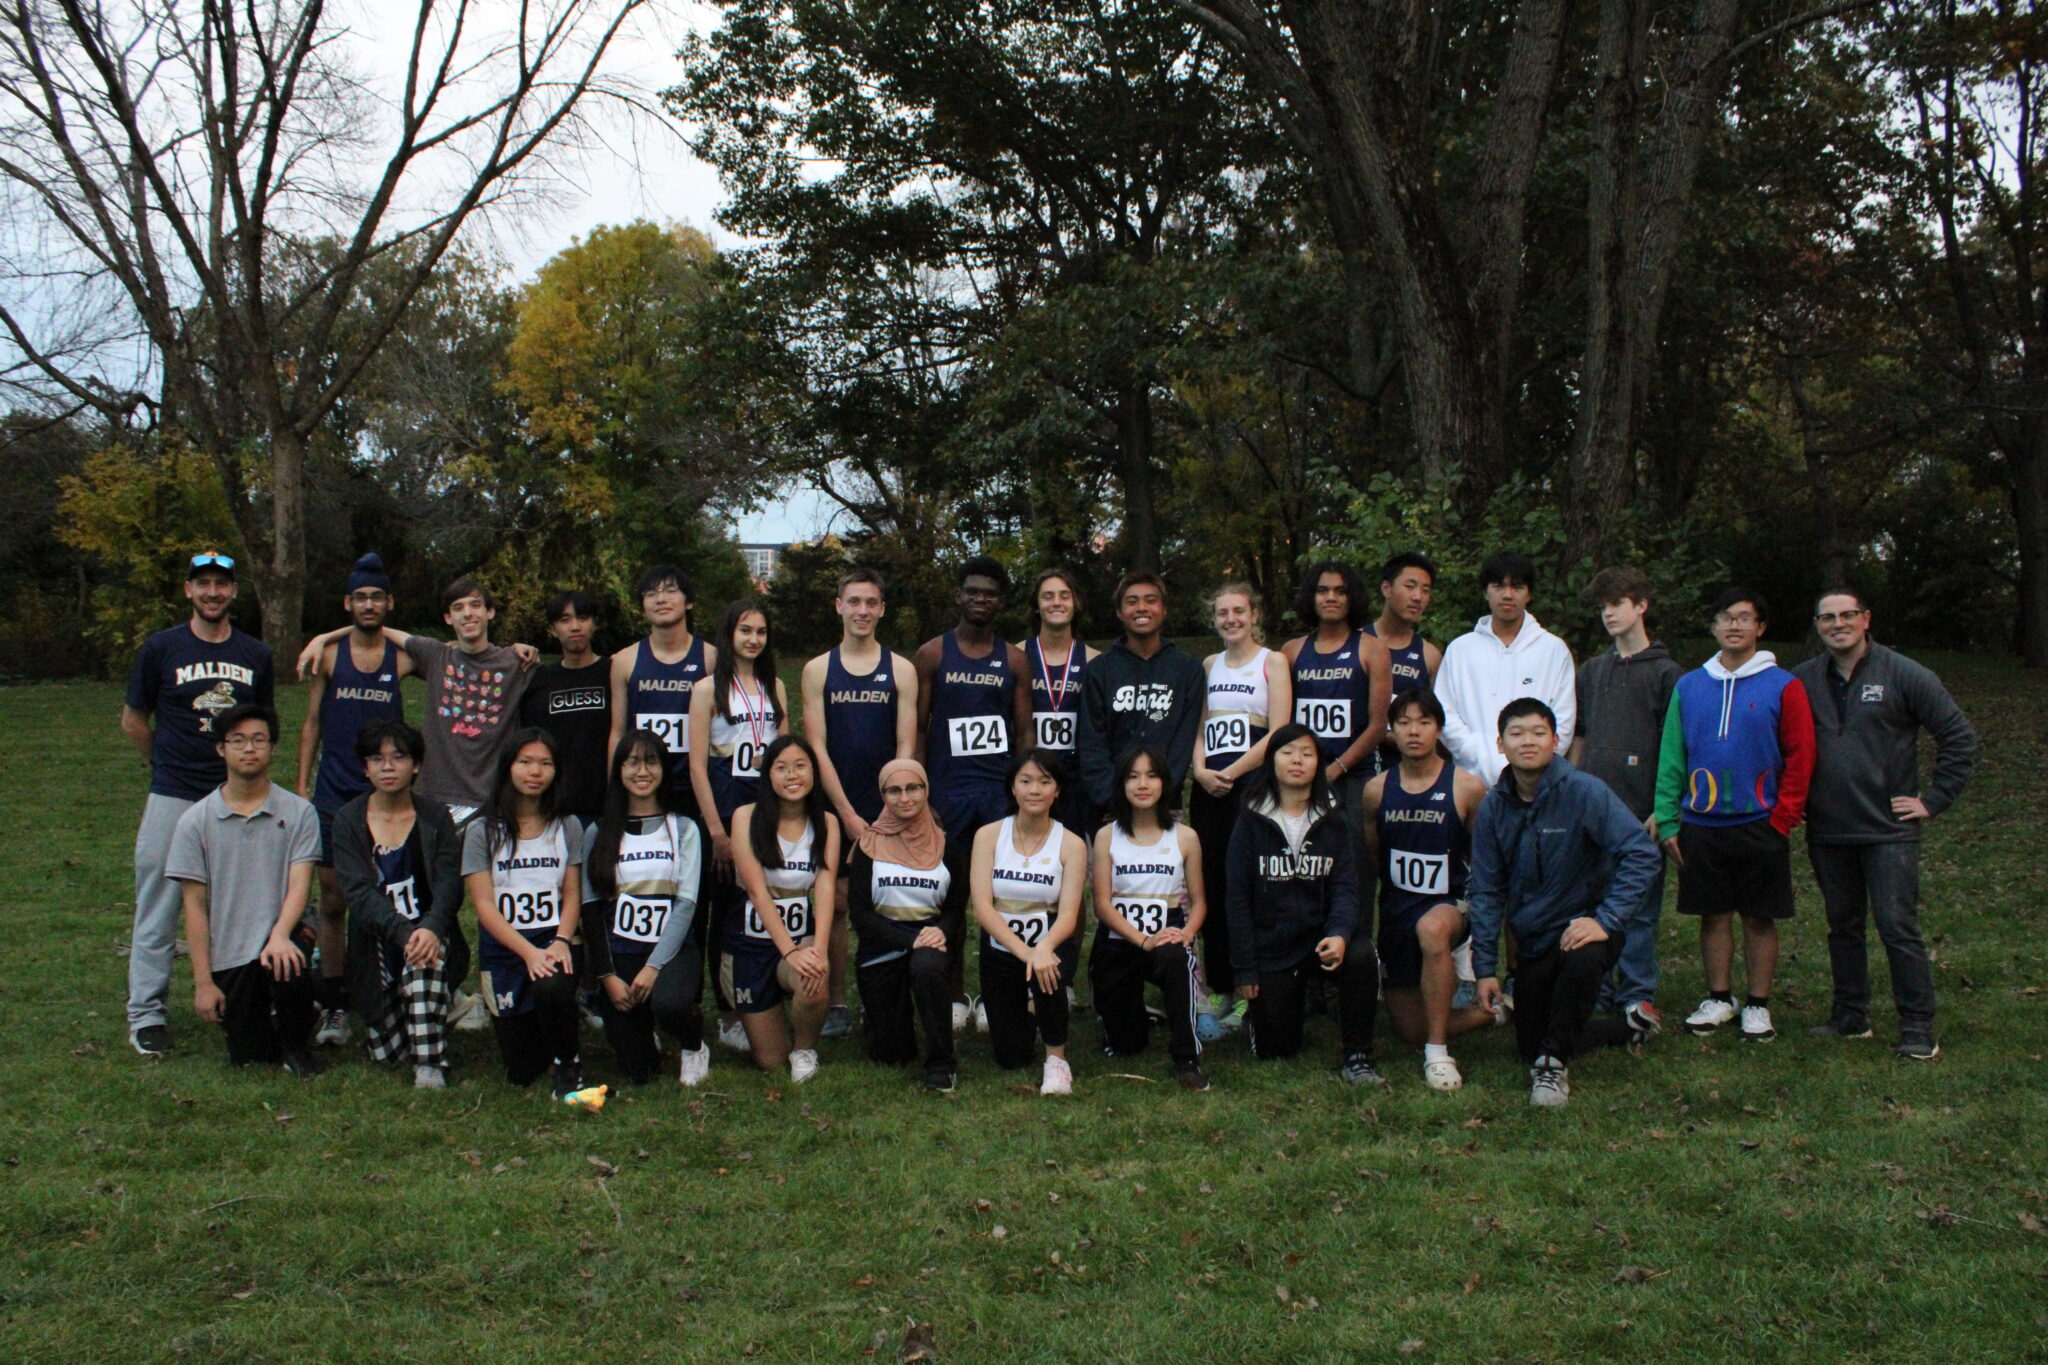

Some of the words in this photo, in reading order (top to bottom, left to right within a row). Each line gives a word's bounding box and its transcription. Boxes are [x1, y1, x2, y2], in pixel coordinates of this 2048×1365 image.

[175, 662, 254, 686] MALDEN
[946, 672, 1004, 687] MALDEN
[1298, 668, 1353, 682] MALDEN
[1032, 679, 1083, 694] ADEN
[1209, 684, 1255, 695] MALDEN
[337, 687, 392, 703] MALDEN
[552, 691, 602, 708] GUESS
[831, 690, 890, 704] MALDEN
[1112, 685, 1174, 712] Band
[1301, 704, 1345, 733] 106
[956, 720, 1002, 751] 124
[1207, 719, 1245, 751] 029
[1385, 809, 1445, 824] MALDEN
[498, 857, 560, 872] MALDEN
[1115, 864, 1175, 876] MALDEN
[1396, 856, 1443, 889] 107
[878, 876, 940, 890] MALDEN
[993, 869, 1054, 886] MALDEN
[499, 890, 554, 924] 035
[619, 901, 668, 937] 037
[497, 992, 513, 1009] M
[736, 988, 752, 1004] M
